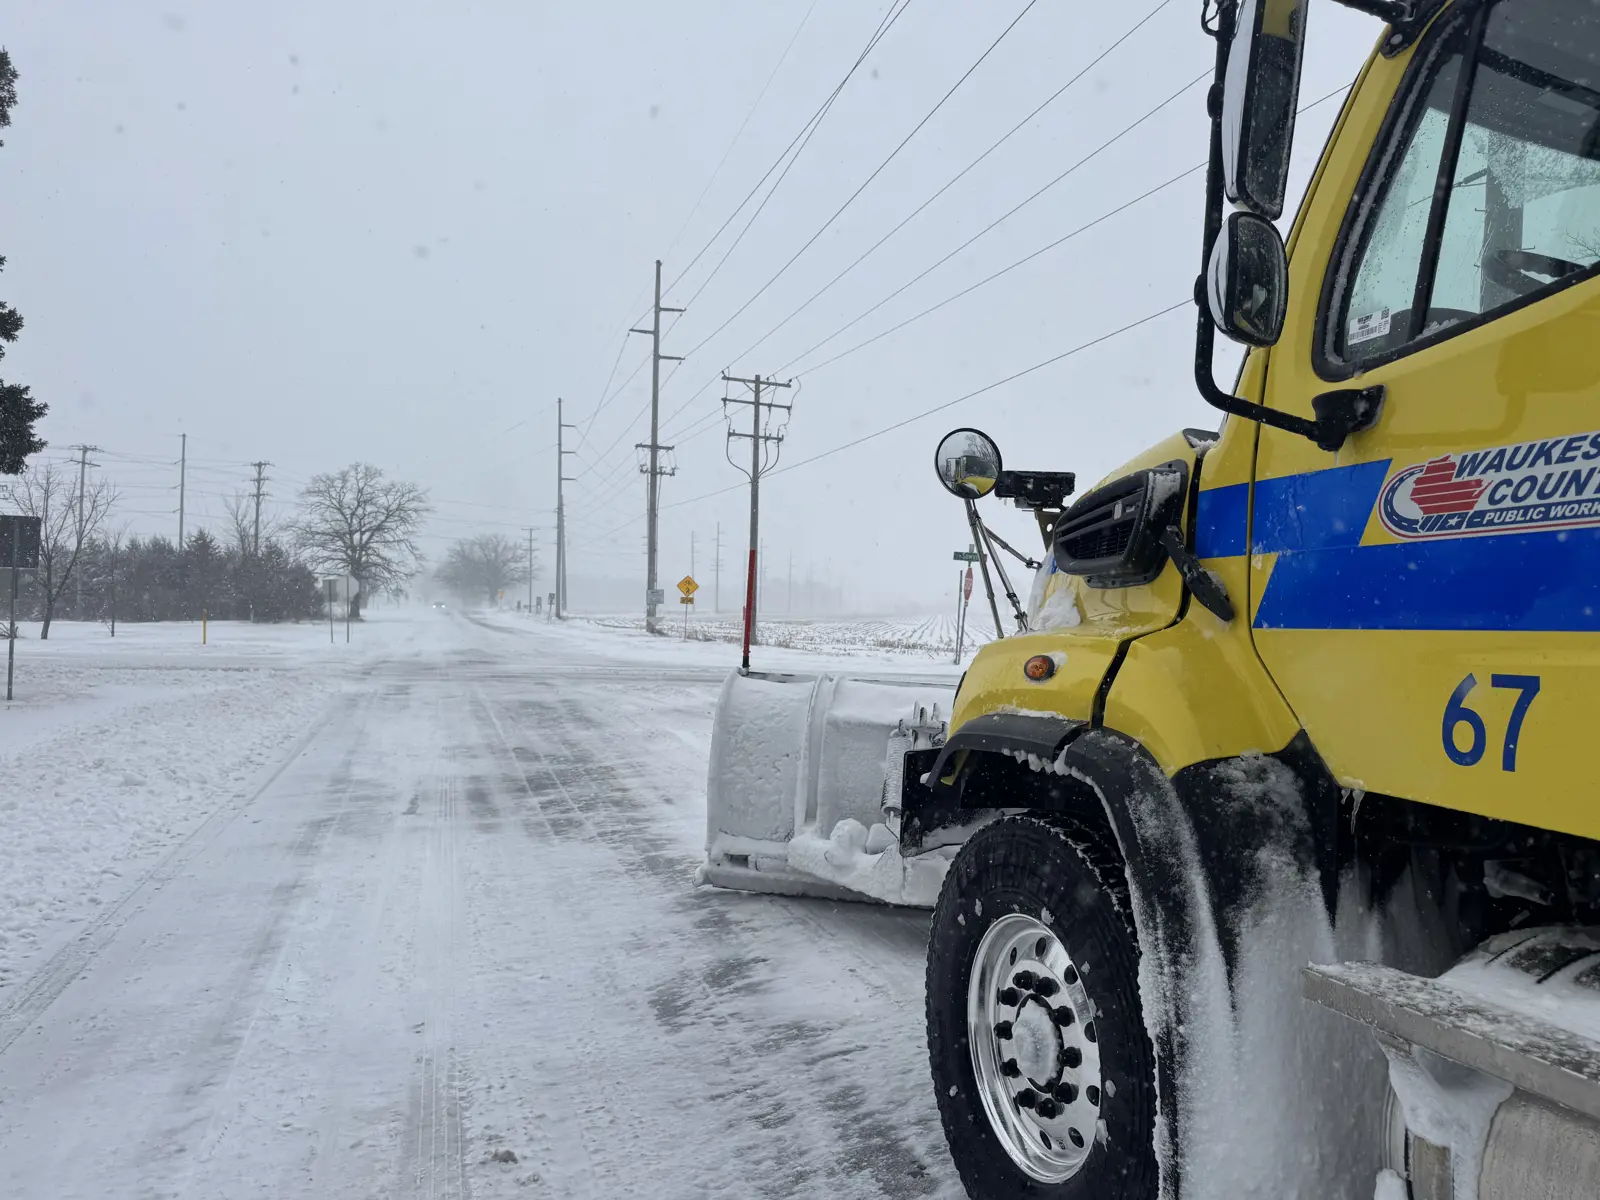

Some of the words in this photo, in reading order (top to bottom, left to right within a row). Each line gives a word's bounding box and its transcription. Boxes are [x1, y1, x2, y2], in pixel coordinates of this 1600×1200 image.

[1488, 467, 1600, 506] COUN
[1482, 507, 1546, 524] PUBLIC
[1442, 672, 1540, 772] 67
